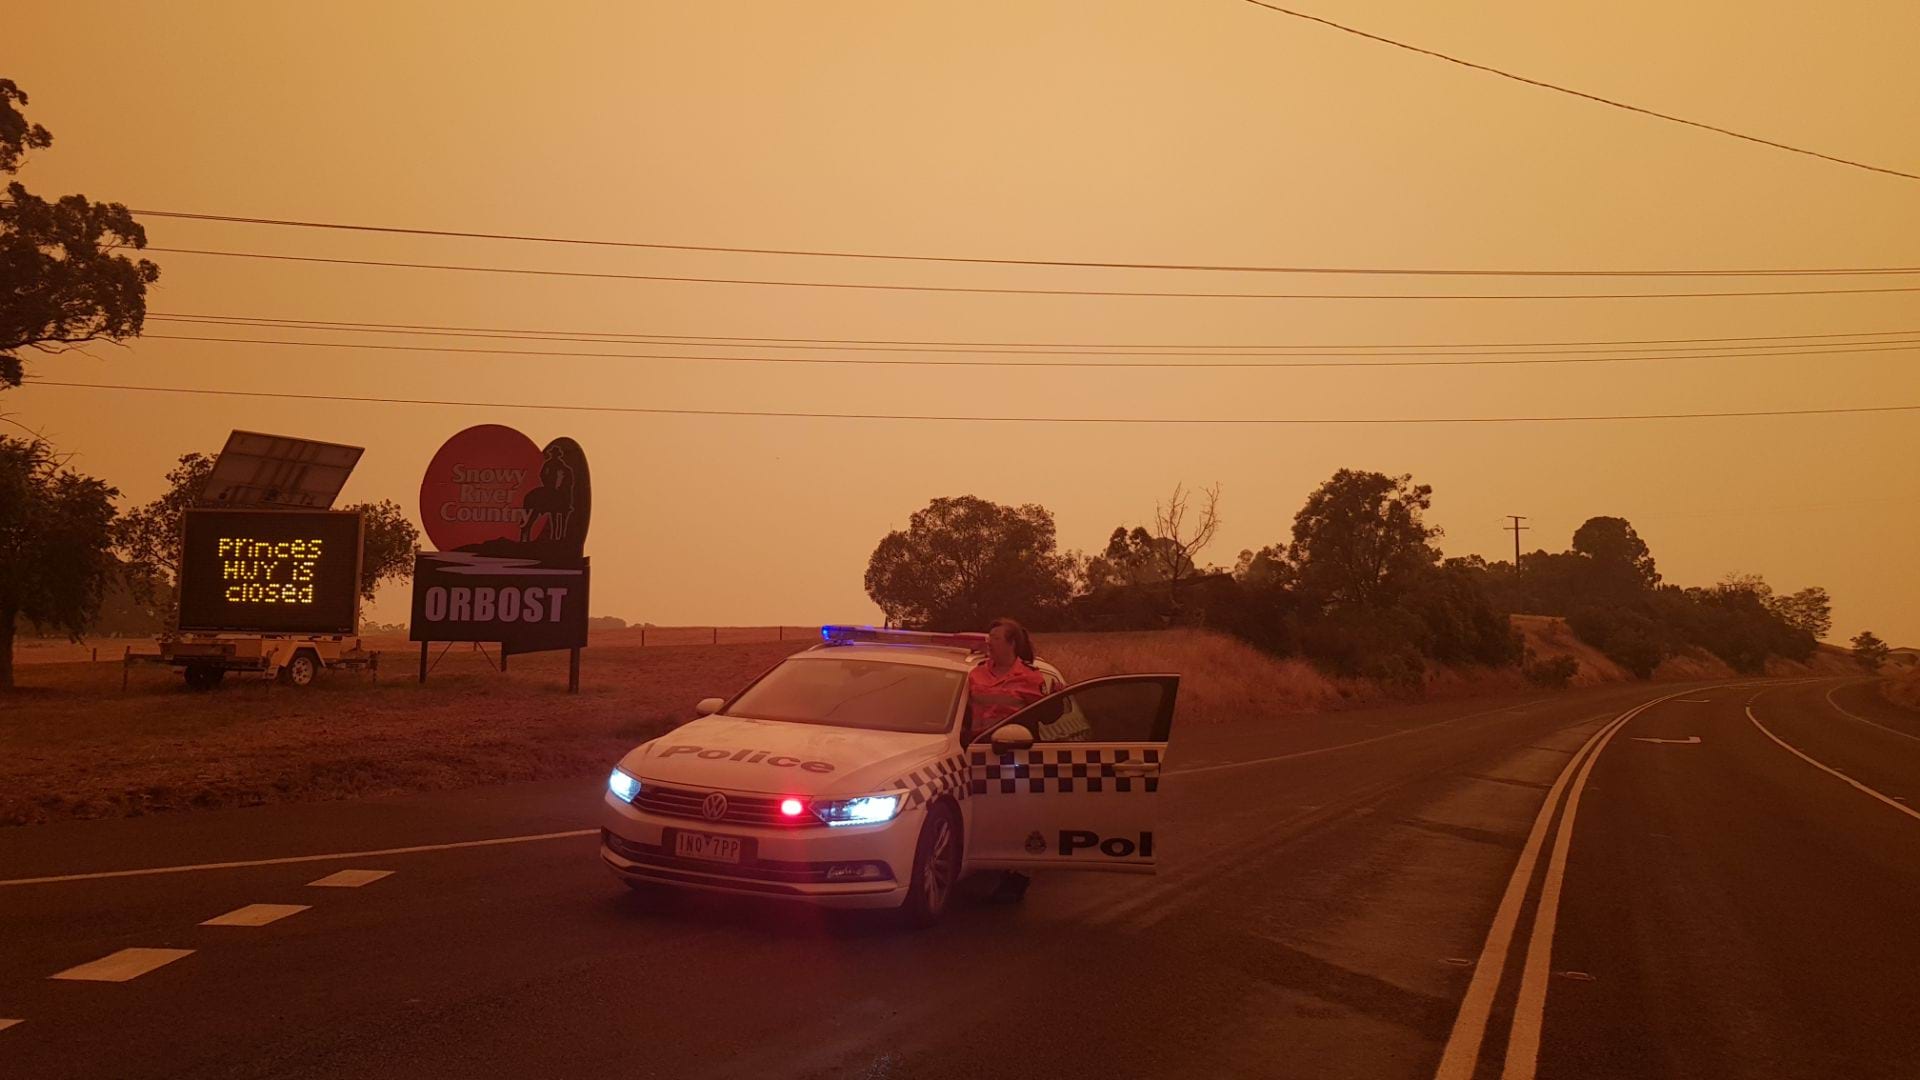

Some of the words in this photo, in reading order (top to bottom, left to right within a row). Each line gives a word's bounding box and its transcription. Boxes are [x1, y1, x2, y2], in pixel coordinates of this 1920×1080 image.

[452, 464, 528, 489] Snowy
[459, 484, 517, 503] River
[440, 501, 534, 527] Country
[218, 538, 323, 559] Princes
[223, 560, 279, 580] HWY
[292, 561, 315, 581] is
[225, 583, 314, 604] closed
[424, 586, 568, 623] ORBOST
[658, 745, 835, 773] Police
[1059, 830, 1153, 857] Pol
